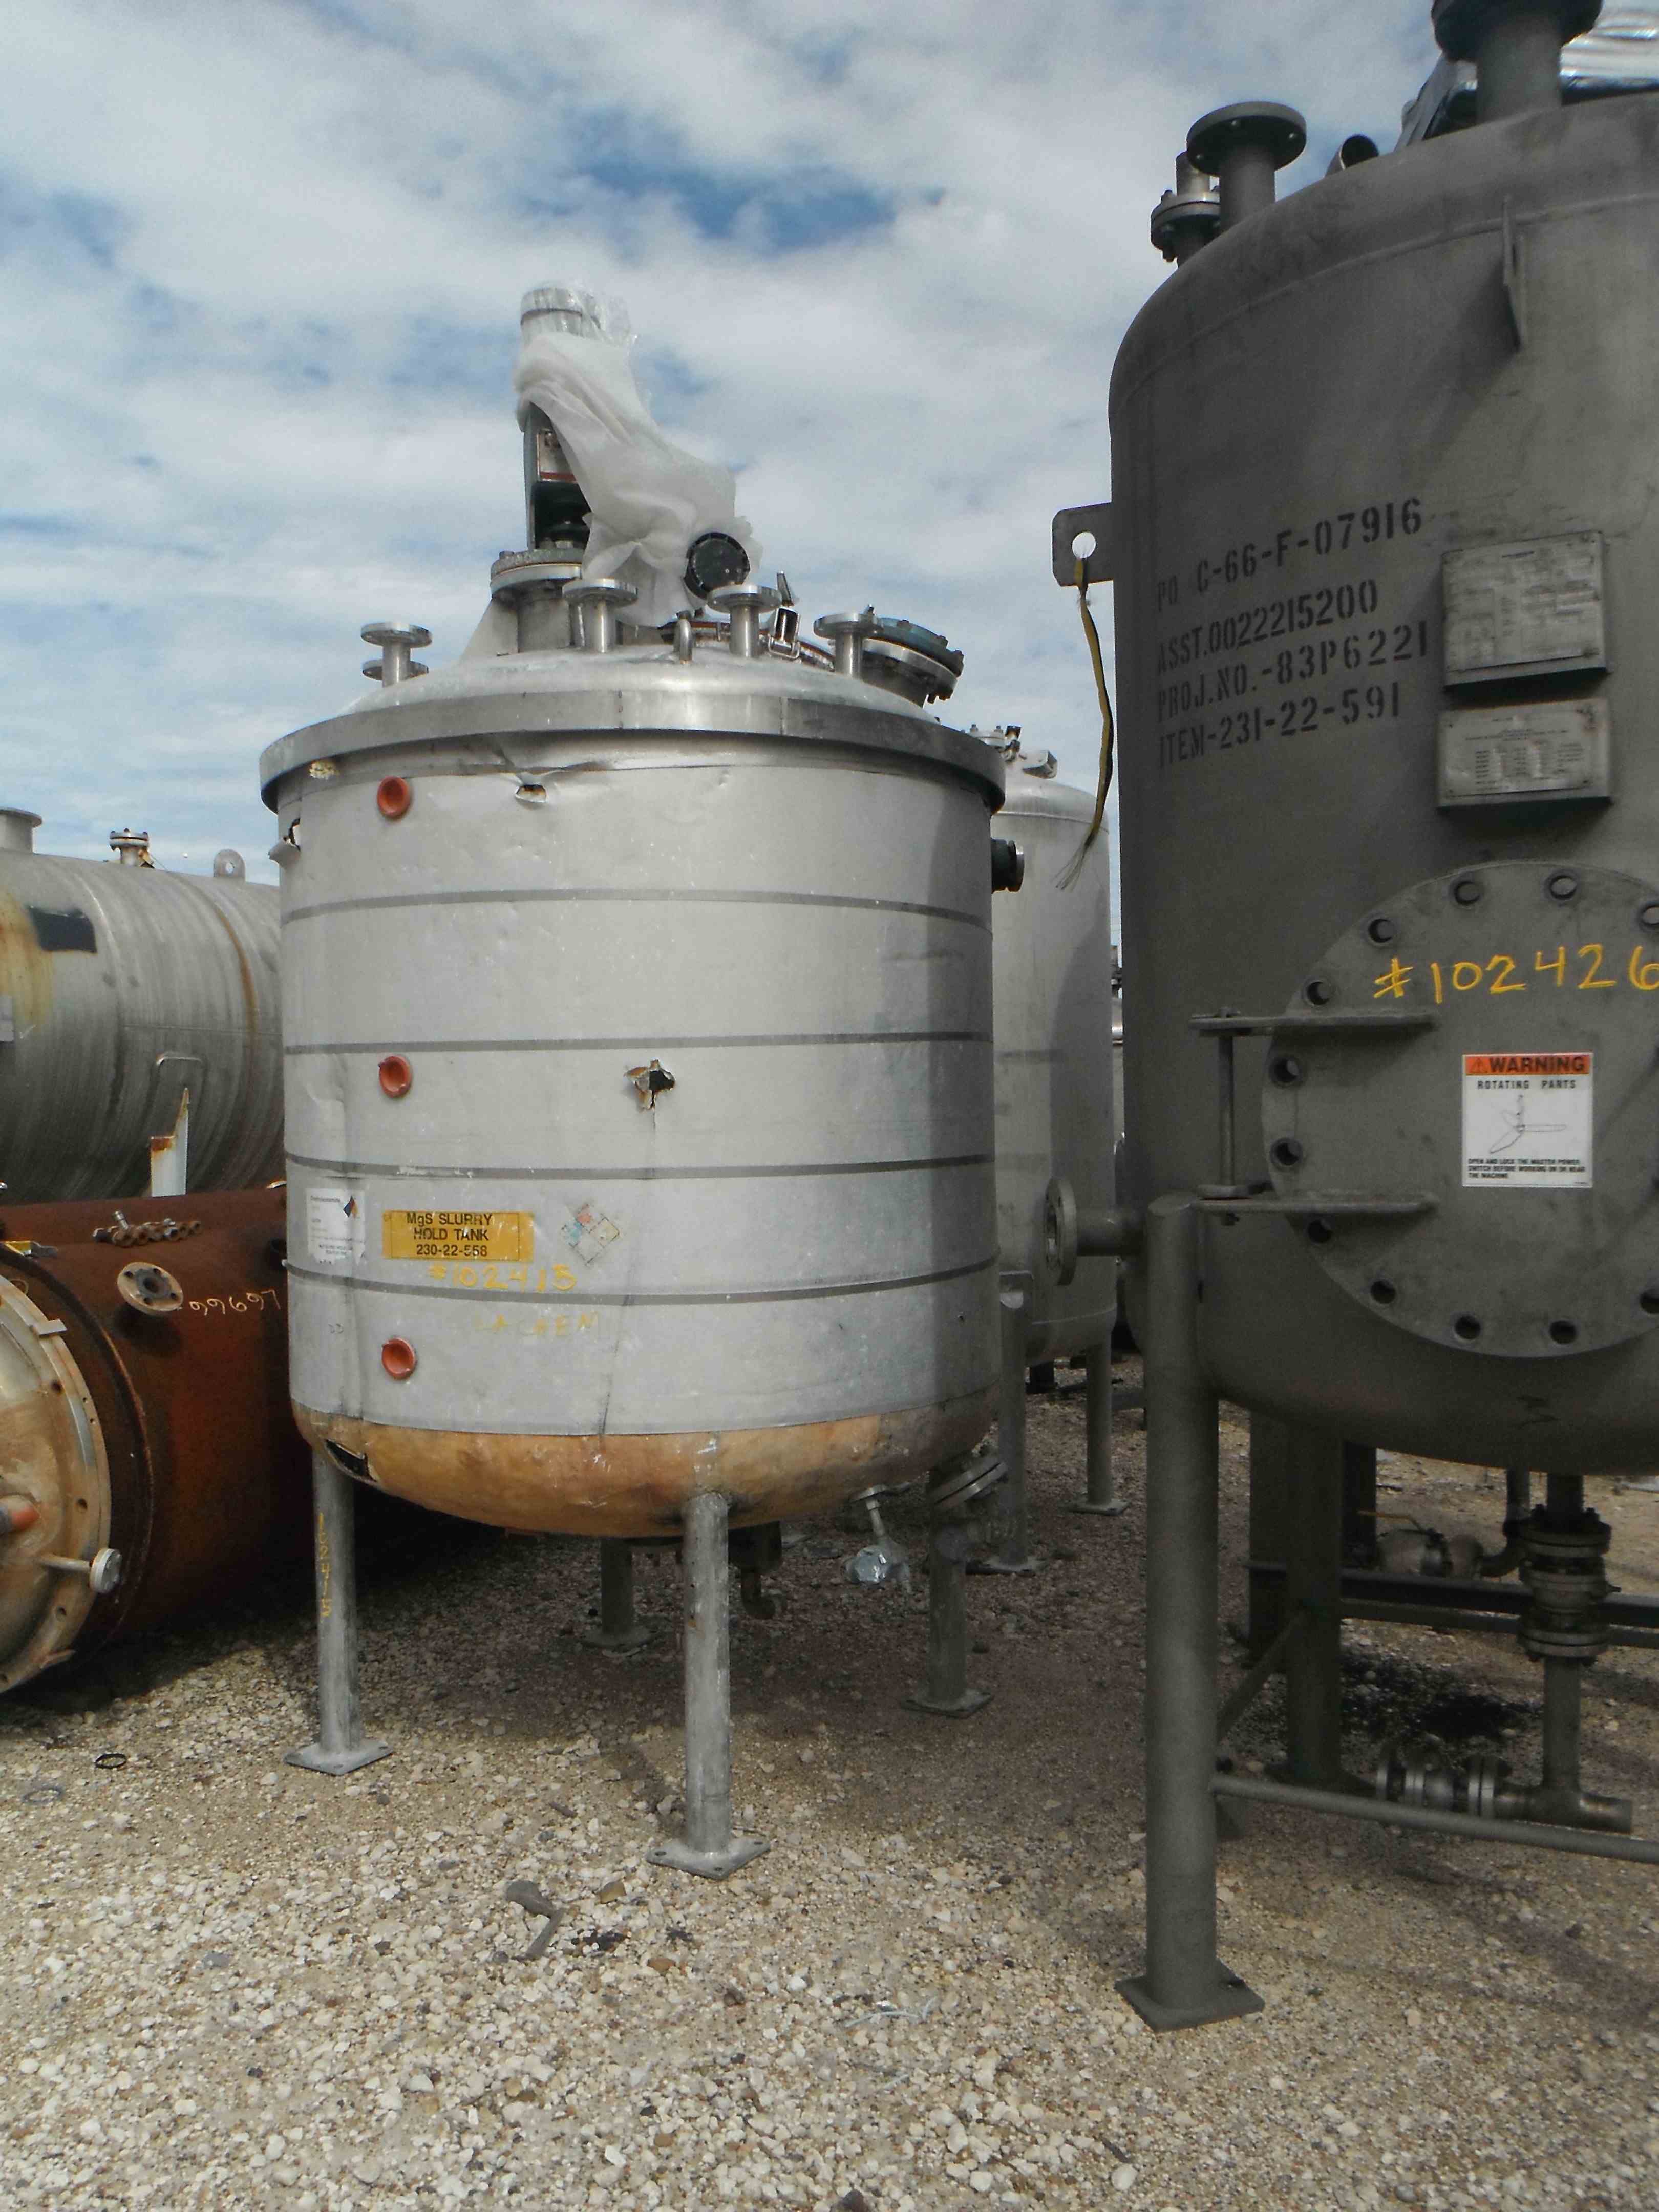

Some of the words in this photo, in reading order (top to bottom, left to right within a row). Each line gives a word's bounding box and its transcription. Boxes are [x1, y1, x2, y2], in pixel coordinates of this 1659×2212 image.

[1197, 498, 1422, 593] C-66-F-07916
[1374, 944, 1659, 1004] #102426
[1490, 1056, 1584, 1072] WARNING
[1478, 1080, 1529, 1089] ROTATING
[1541, 1080, 1576, 1089] PARTS
[407, 1212, 433, 1227] MgS
[439, 1213, 492, 1225] SLURRY
[413, 1228, 448, 1240] HOLD
[454, 1229, 489, 1241] TANK
[416, 1244, 487, 1257] 230-22-558
